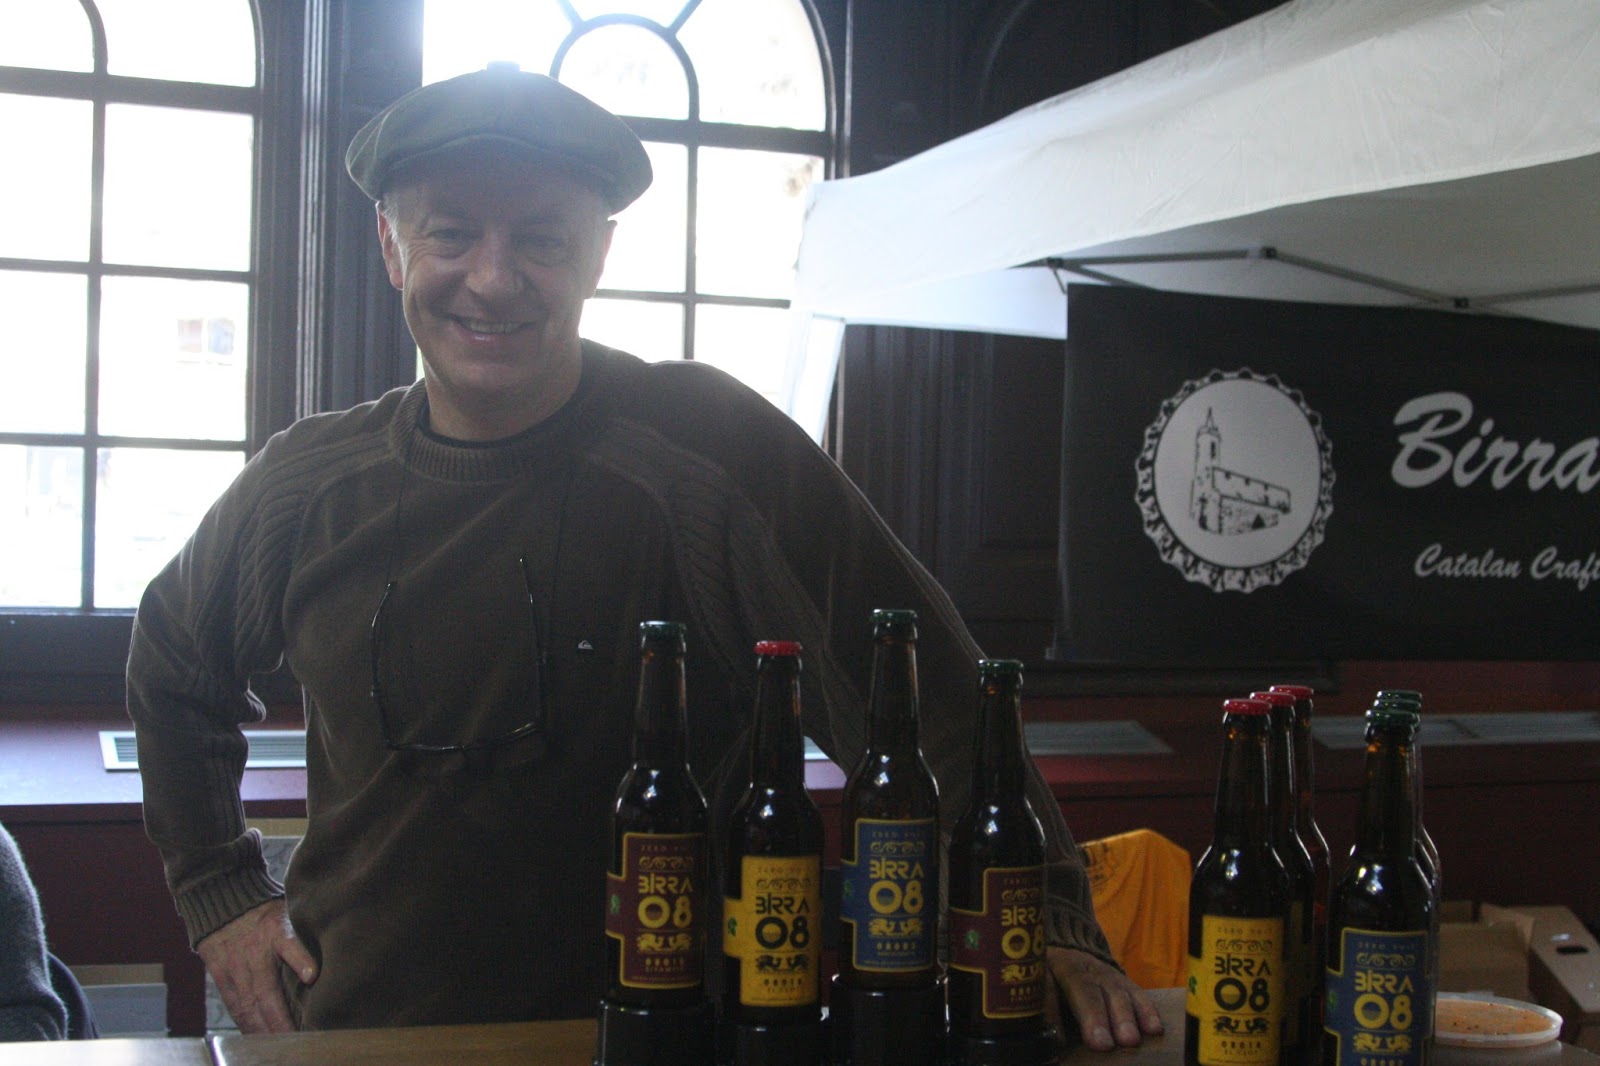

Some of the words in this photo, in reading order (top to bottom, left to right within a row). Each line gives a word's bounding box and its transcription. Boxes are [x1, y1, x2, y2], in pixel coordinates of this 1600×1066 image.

[1392, 391, 1600, 493] Birra
[1414, 543, 1521, 578] Catalan
[638, 873, 693, 895] BIRRA
[869, 857, 925, 880] BIRRA
[638, 895, 692, 929] 08
[755, 893, 809, 915] BIRRA
[869, 880, 924, 914] 08
[755, 916, 809, 949] 08
[1002, 924, 1044, 960] 08
[1215, 954, 1272, 977] BIRRA
[1355, 970, 1415, 994] BIRRA
[1214, 977, 1270, 1012] 08
[1354, 993, 1413, 1031] 08
